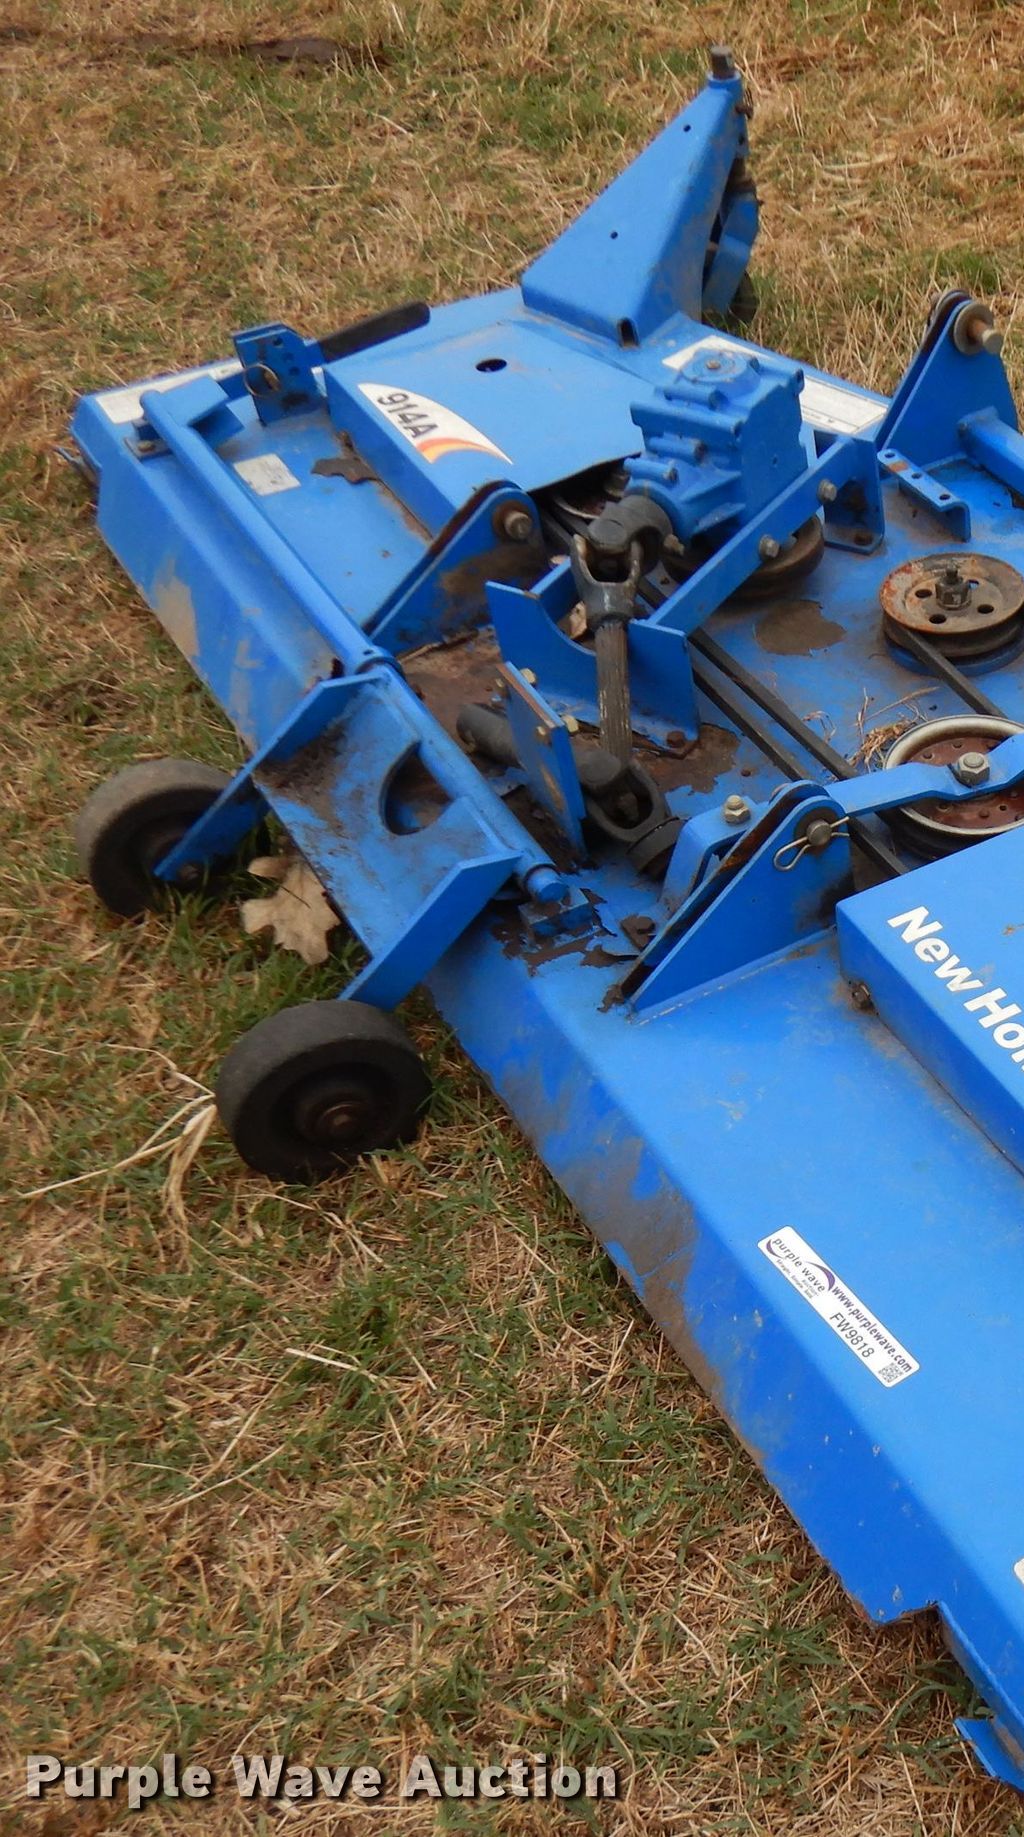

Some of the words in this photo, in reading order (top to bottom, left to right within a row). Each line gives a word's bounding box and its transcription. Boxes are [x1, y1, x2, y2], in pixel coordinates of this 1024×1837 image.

[377, 392, 439, 439] 914A
[887, 905, 984, 992] New
[772, 1238, 803, 1268] purple
[801, 1267, 826, 1293] wave
[829, 1311, 876, 1359] FW9818
[831, 1285, 913, 1374] www.purplewave.com
